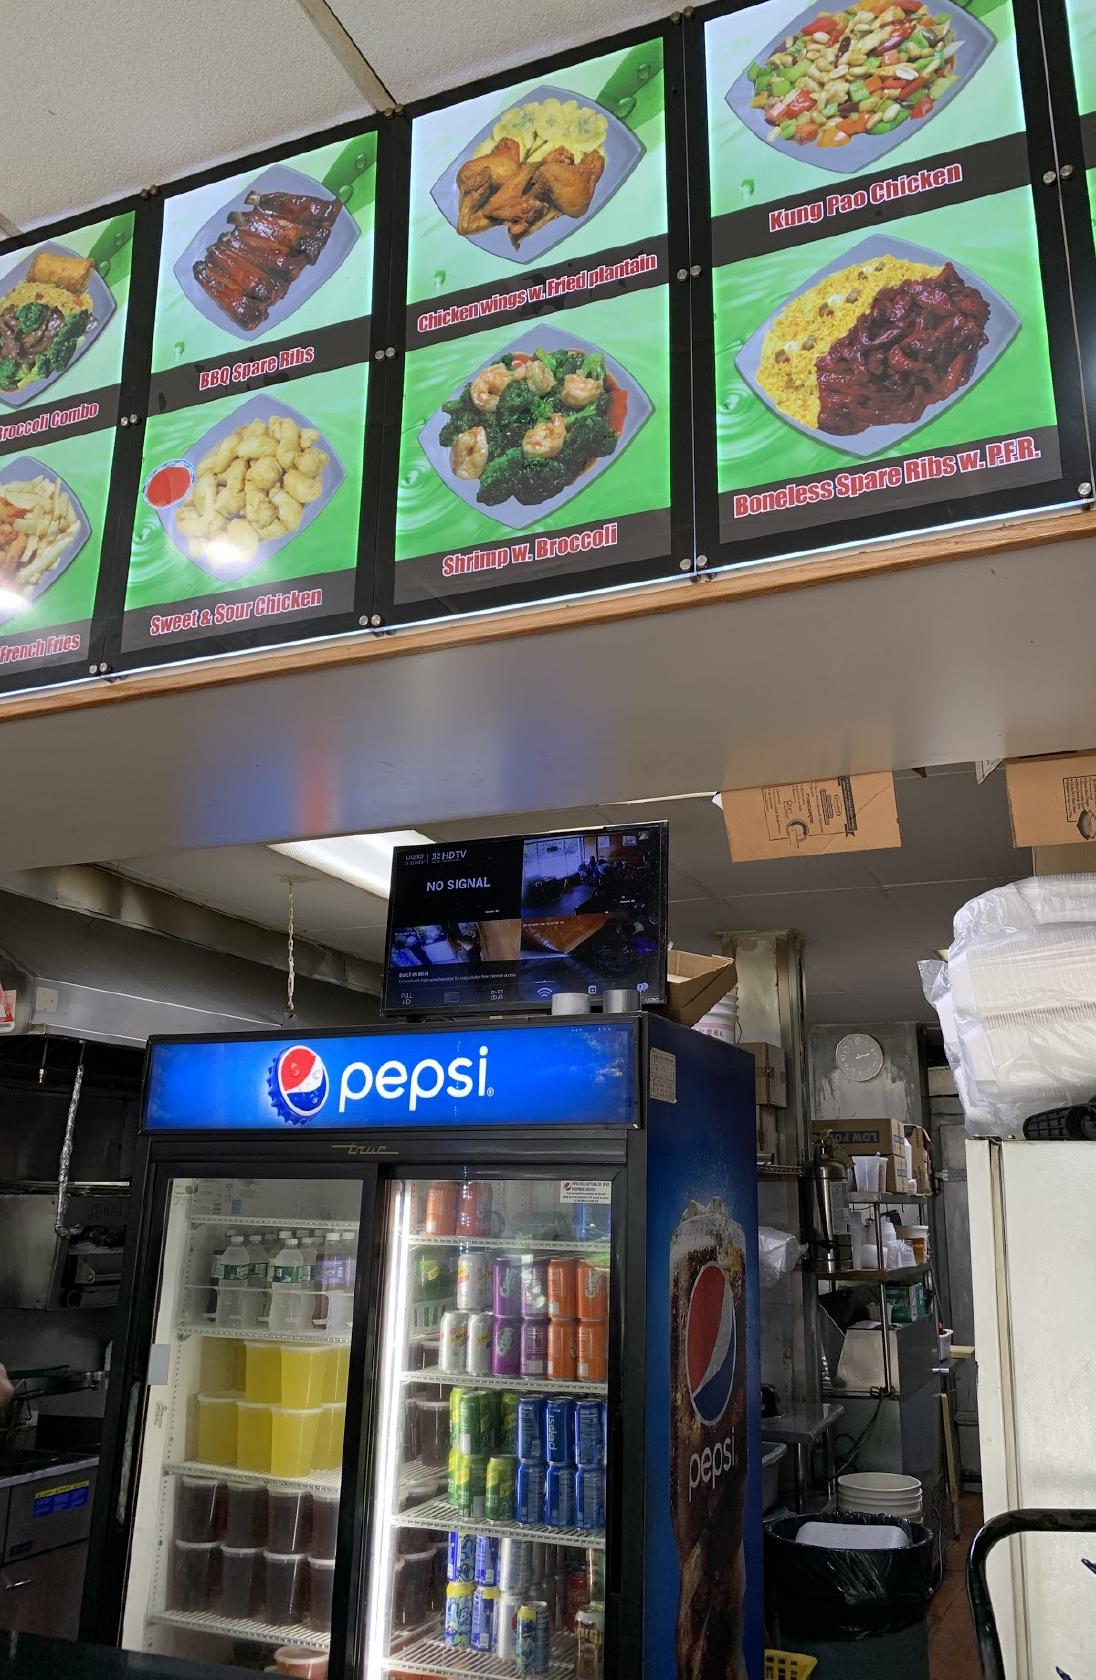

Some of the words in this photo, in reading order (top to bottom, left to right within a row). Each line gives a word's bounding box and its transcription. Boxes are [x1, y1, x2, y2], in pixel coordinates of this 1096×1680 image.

[769, 201, 823, 232] Kung
[826, 189, 868, 216] Pao
[869, 163, 963, 204] Chicken
[417, 301, 479, 333] Chicken
[479, 289, 527, 317] wings
[526, 283, 546, 304] w.
[546, 270, 588, 299] Fried
[588, 254, 657, 288] plantain
[199, 366, 231, 391] BBQ
[232, 356, 278, 382] Spare
[279, 346, 314, 370] Ribs
[50, 402, 99, 428] Combo
[733, 478, 833, 518] Boneless
[835, 465, 902, 497] Spare
[904, 455, 956, 484] Ribs
[957, 449, 985, 473] w.
[986, 436, 1041, 468] P.F.R.
[442, 546, 510, 576] Shrimp
[511, 543, 533, 563] w.
[535, 522, 618, 560] Broccoli
[150, 610, 199, 636] Sweet
[199, 608, 212, 626] &
[214, 601, 253, 624] Sour
[254, 589, 322, 616] Chicken
[46, 634, 81, 656] Fries
[442, 849, 467, 860] HDTV
[426, 881, 444, 892] NO
[447, 876, 491, 890] SIGNAL
[339, 1045, 489, 1113] pepsi
[689, 1426, 735, 1502] pepsi
